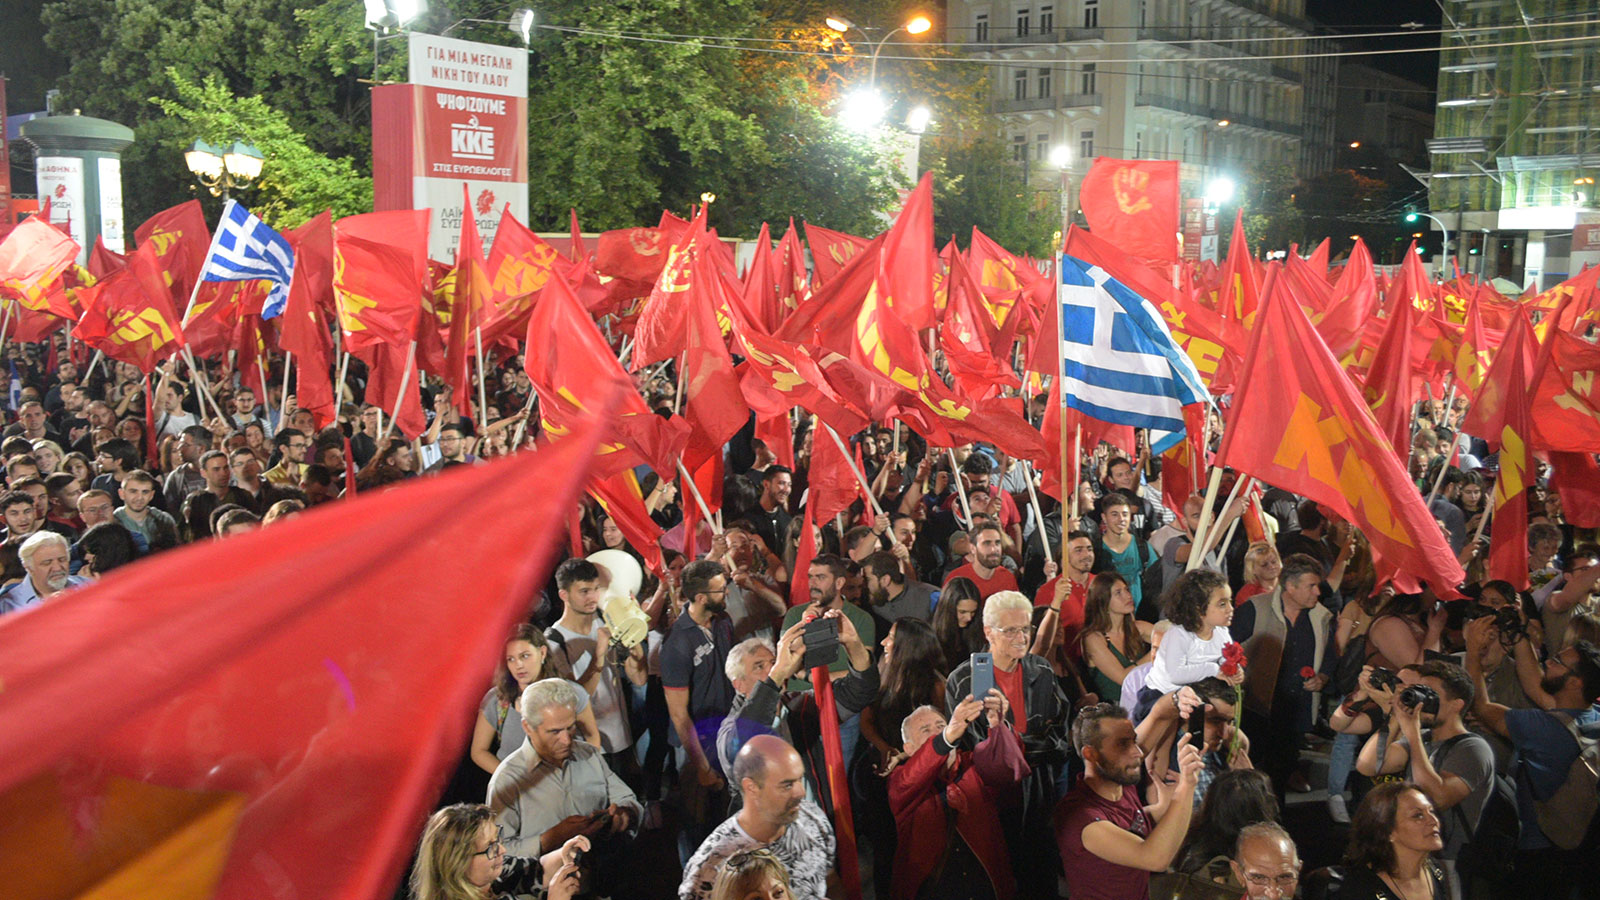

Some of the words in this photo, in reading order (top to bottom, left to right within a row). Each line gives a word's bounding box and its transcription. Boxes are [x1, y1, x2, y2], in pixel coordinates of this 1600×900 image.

[427, 46, 445, 61] ΓΙΑ
[448, 49, 468, 64] ΜΙΑ
[471, 53, 513, 70] ΜΕΓΑΛΗ
[432, 66, 458, 81] ΝΙΚΗ
[460, 70, 480, 83] ΤΟΥ
[483, 73, 509, 87] ΛΑΟΥ
[436, 92, 507, 115] ΨΗΦΙΖΟΥΜΕ
[451, 128, 495, 154] ΚΚΕ
[433, 163, 453, 173] ΣΤΙΣ
[453, 164, 512, 177] ΕΥΡΩΕΚΛΟΓΕΣ
